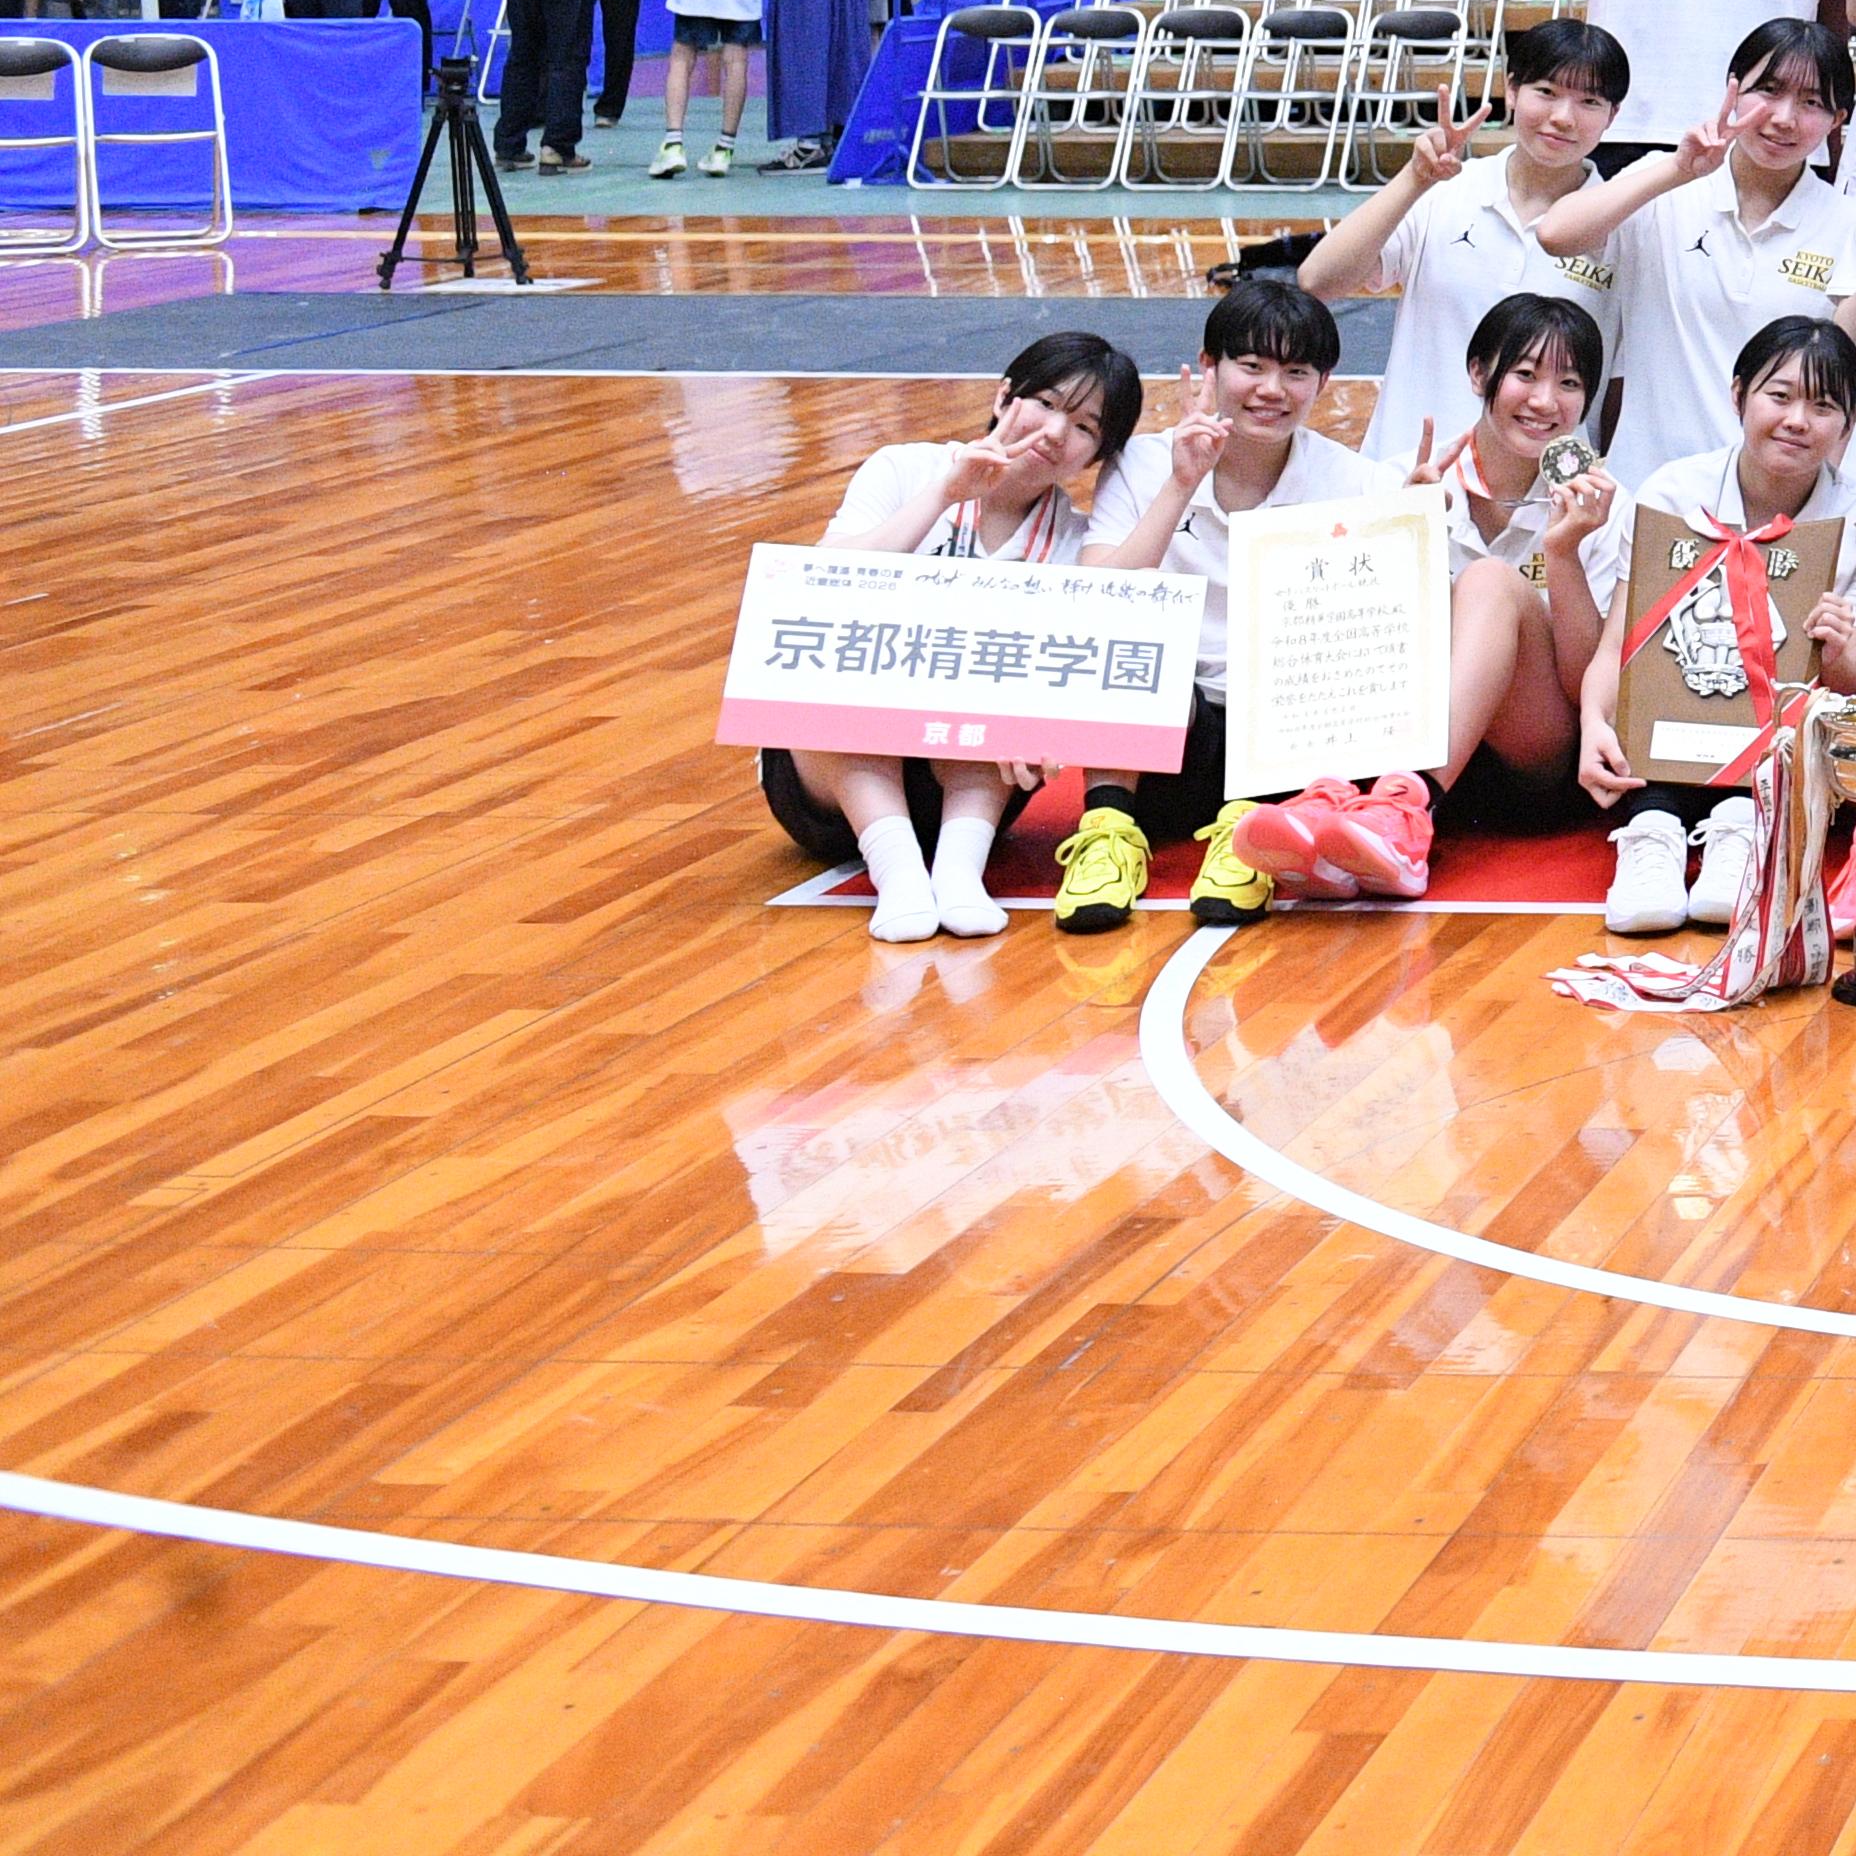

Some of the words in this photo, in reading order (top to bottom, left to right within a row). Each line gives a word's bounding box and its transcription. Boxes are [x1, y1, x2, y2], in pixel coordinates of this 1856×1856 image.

[1796, 250, 1835, 268] KYOTO
[1304, 552, 1375, 583] 賞状
[764, 616, 1166, 694] 京都精華学園
[922, 721, 987, 748] 京都
